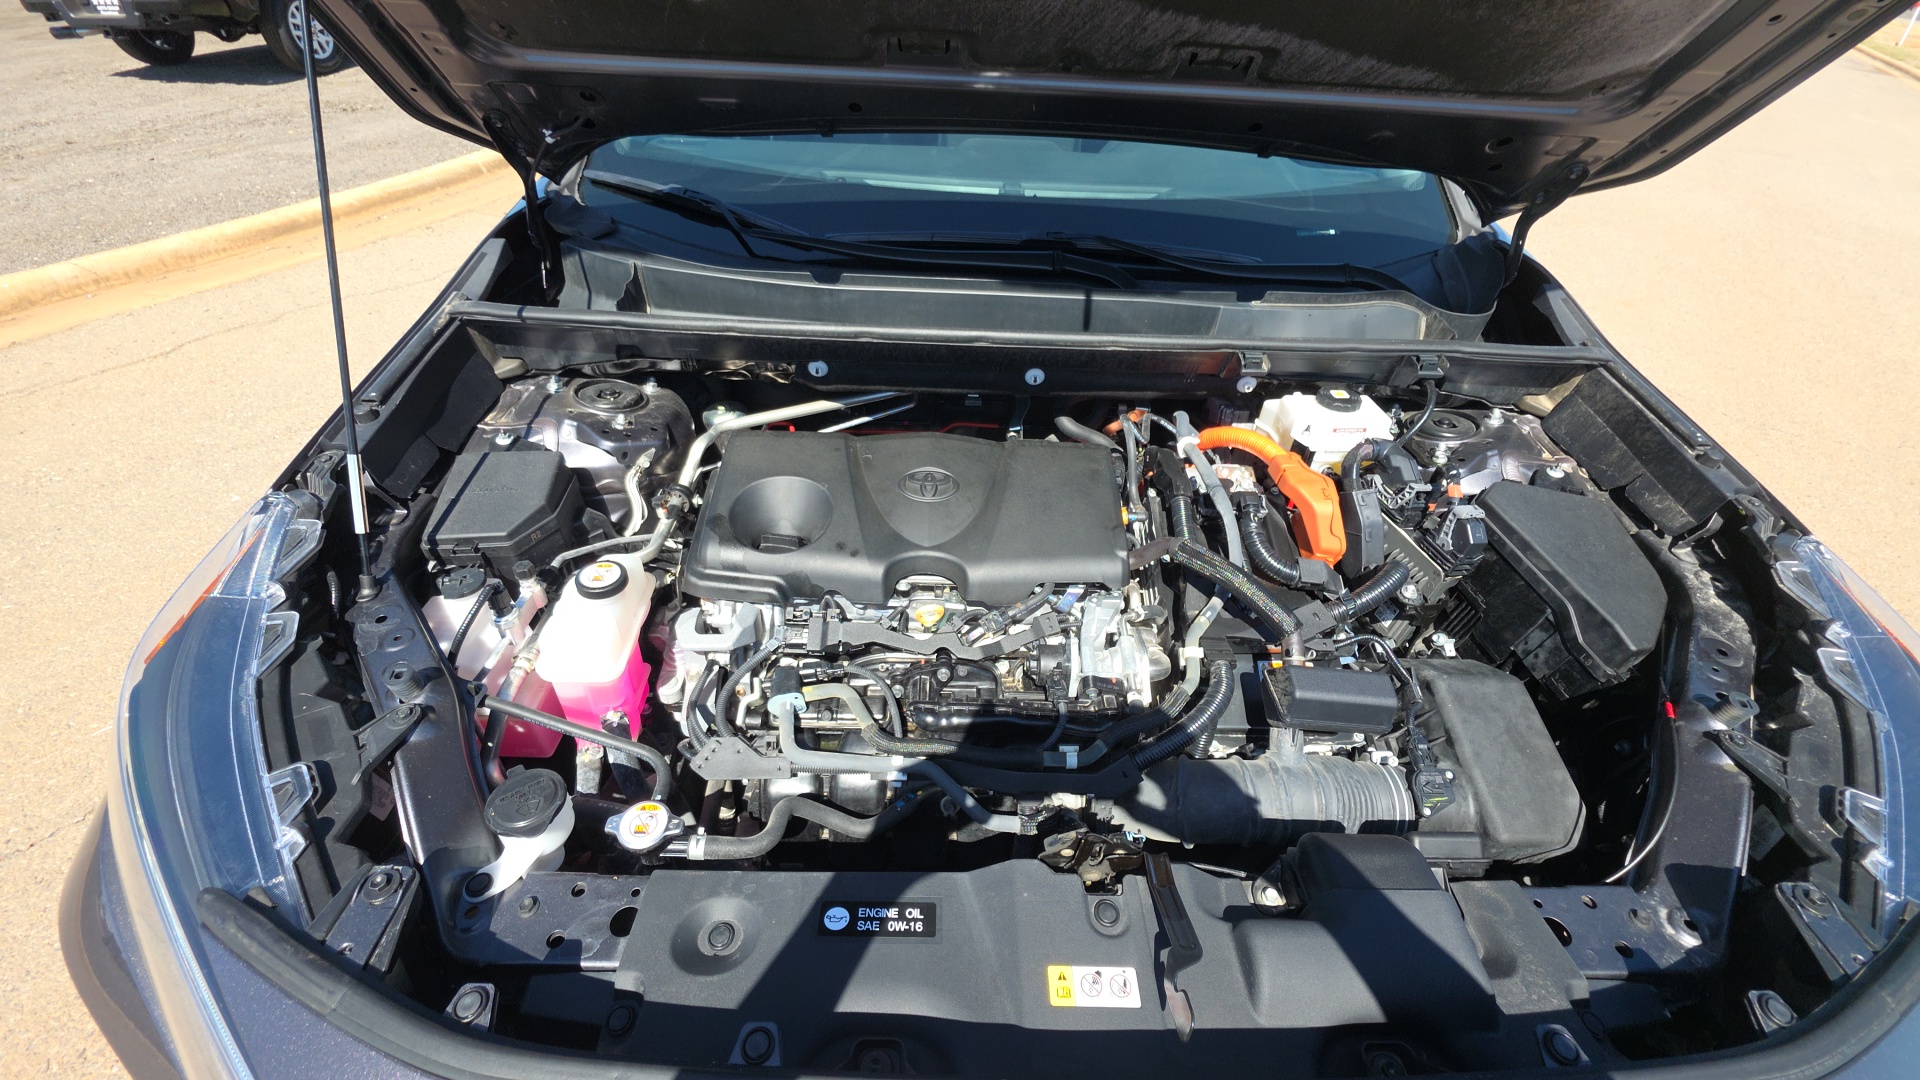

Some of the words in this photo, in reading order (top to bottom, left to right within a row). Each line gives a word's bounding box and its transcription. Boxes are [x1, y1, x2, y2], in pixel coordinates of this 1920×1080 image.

[531, 530, 541, 542] R2
[1580, 653, 1593, 666] L3
[858, 907, 899, 918] ENGINE
[905, 908, 924, 919] OIL
[857, 920, 880, 931] SAE
[887, 921, 924, 932] 0W-16
